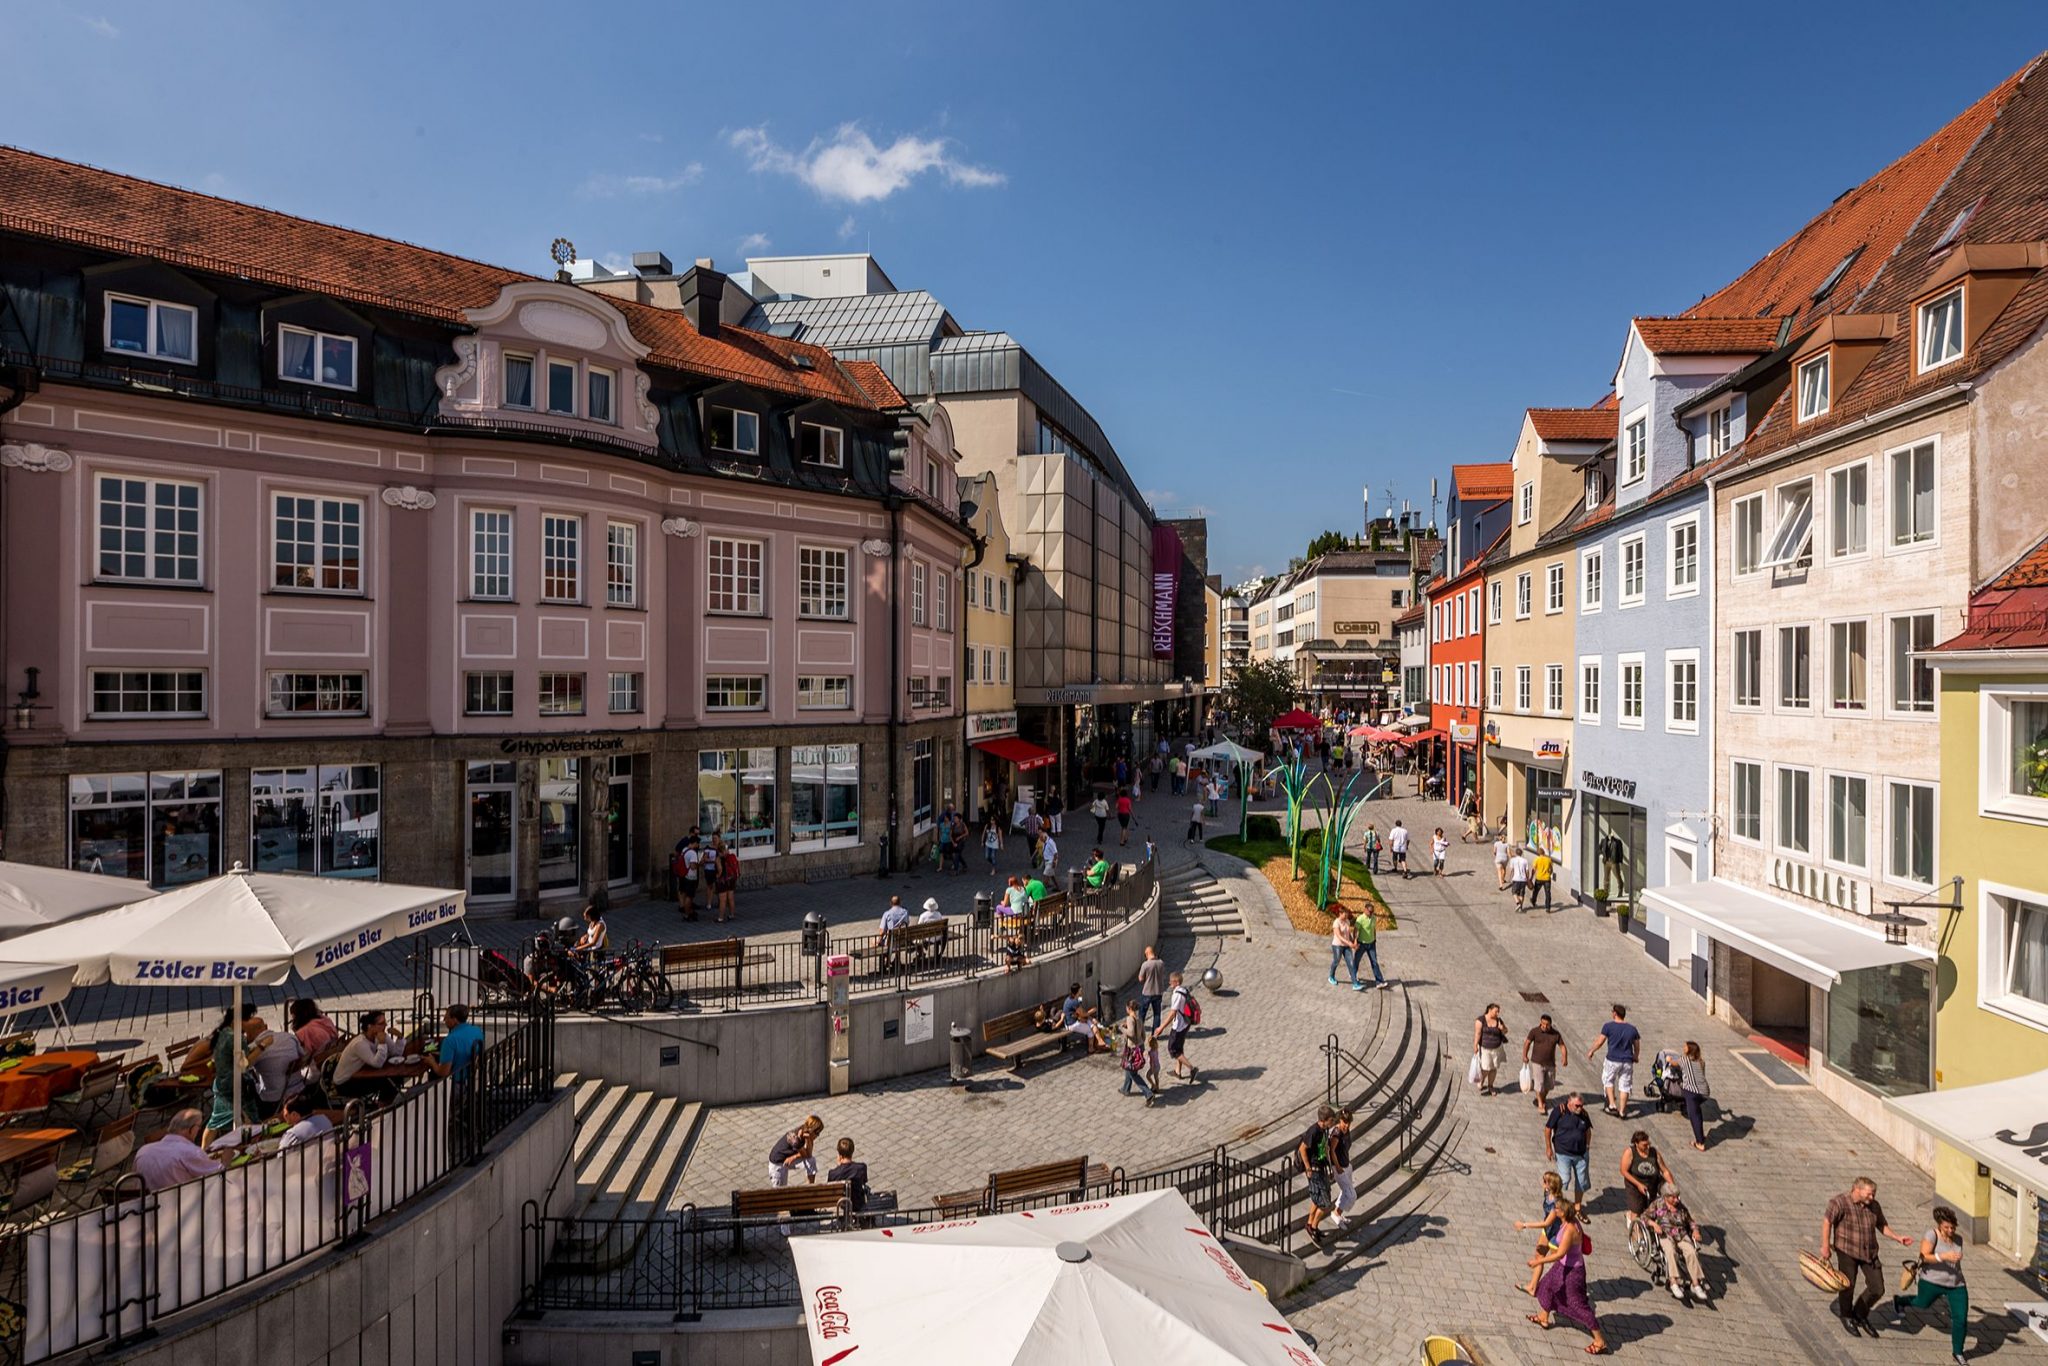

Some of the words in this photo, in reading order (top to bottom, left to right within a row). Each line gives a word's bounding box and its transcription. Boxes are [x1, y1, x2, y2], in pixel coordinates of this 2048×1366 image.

[1153, 573, 1173, 651] REISCHMANN
[1046, 688, 1091, 702] REISCHMANN
[518, 737, 624, 755] HypoVereinsbank
[1541, 741, 1560, 752] dm
[1774, 858, 1858, 912] COURAGE
[407, 907, 437, 929] Zötler
[438, 902, 457, 918] Bier
[314, 937, 357, 969] Zötler
[358, 927, 382, 950] Bier
[136, 960, 205, 979] Zötler
[211, 960, 258, 980] Bier
